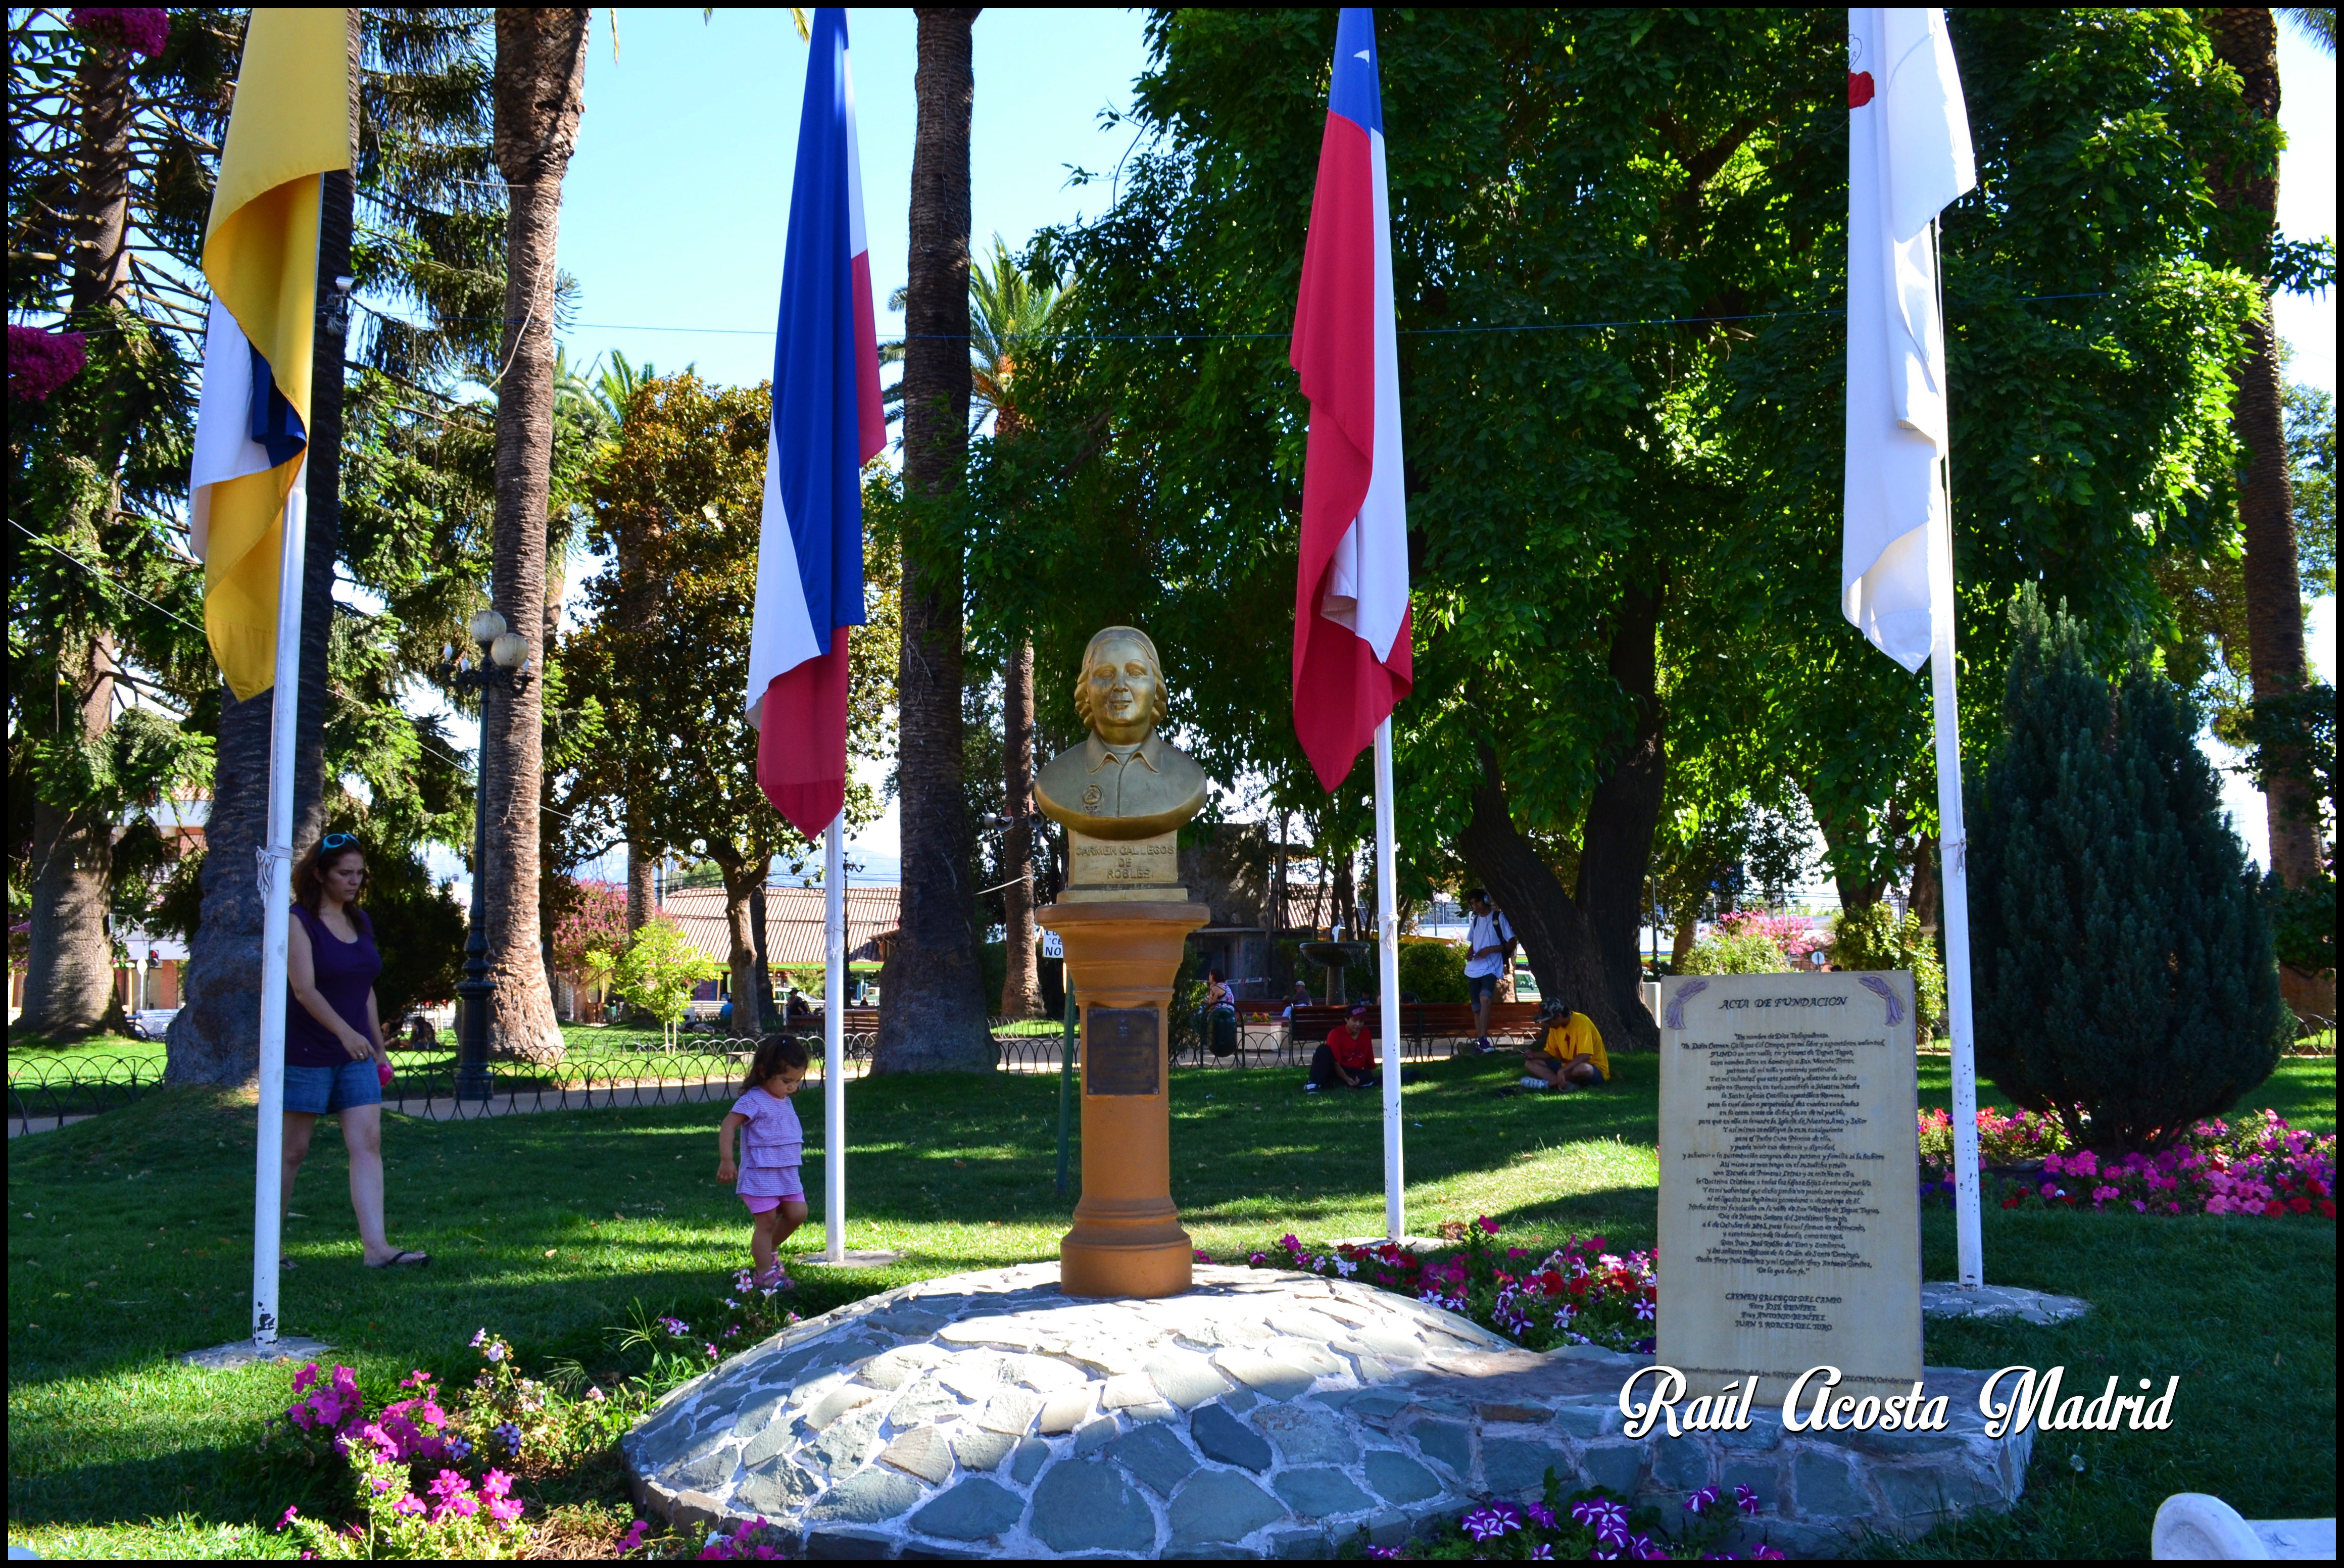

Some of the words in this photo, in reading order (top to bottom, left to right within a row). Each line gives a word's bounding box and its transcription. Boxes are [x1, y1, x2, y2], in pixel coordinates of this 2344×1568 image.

[1076, 846, 1117, 856] CARMEN
[1119, 846, 1175, 855] GALLEGOS
[1118, 858, 1132, 867] DE
[1107, 869, 1150, 878] ROBLES
[1046, 947, 1061, 956] NO
[1719, 999, 1750, 1009] ACTA
[1754, 999, 1772, 1008] DE
[1774, 997, 1848, 1008] FUNDACION
[1759, 1294, 1797, 1303] GALLEGOS
